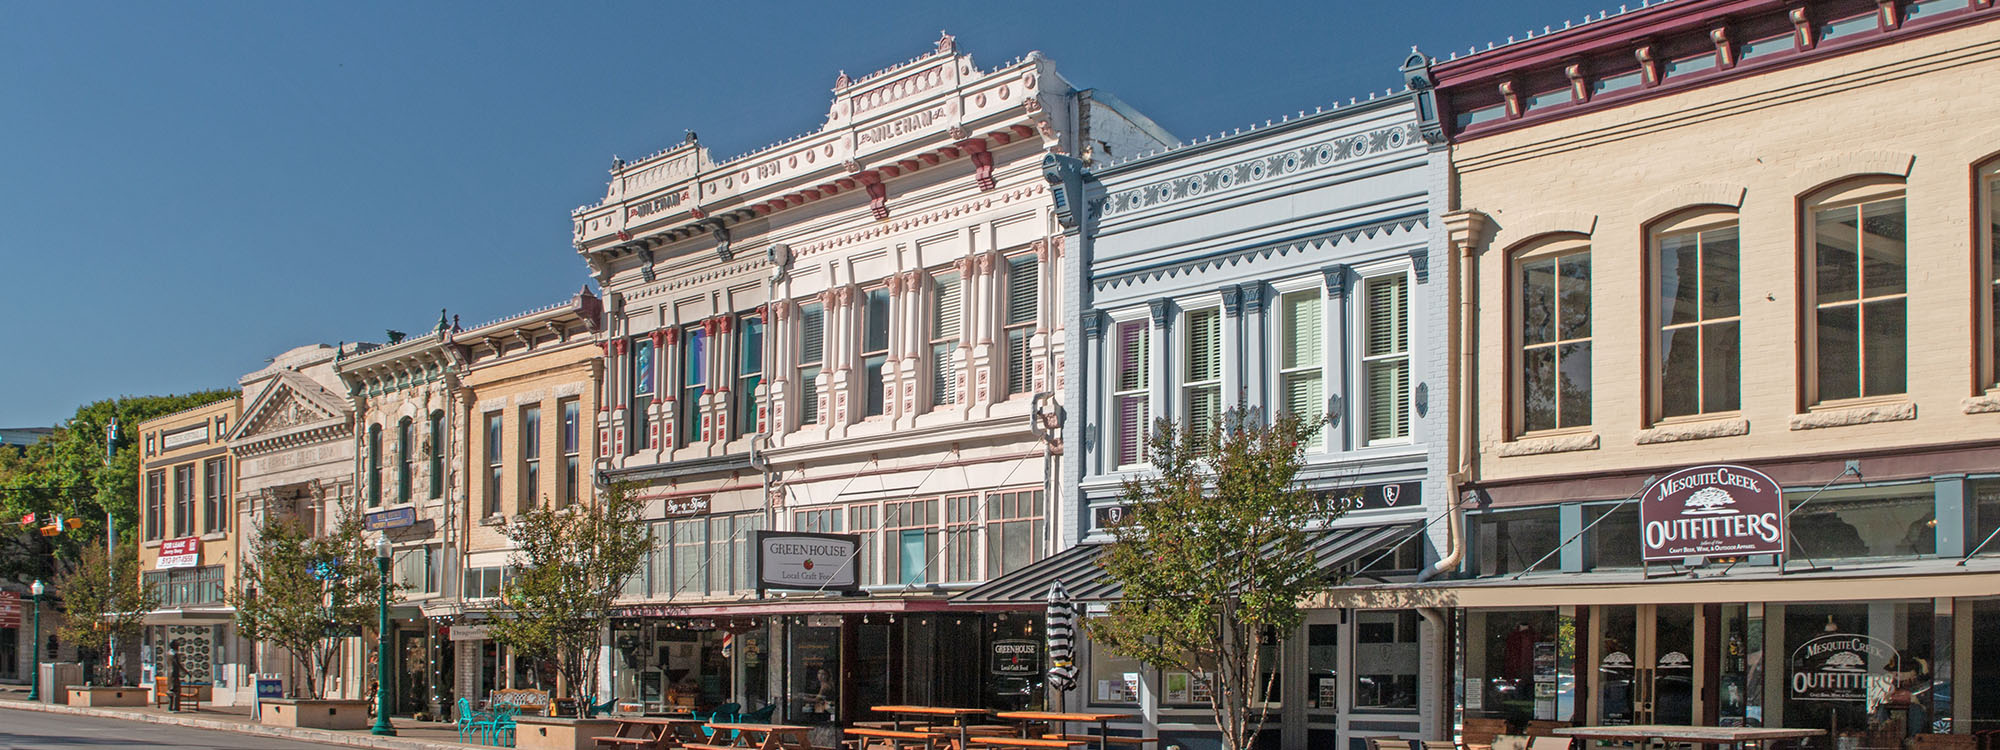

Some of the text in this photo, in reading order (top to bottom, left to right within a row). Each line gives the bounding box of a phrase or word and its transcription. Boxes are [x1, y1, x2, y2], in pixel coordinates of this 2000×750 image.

[871, 110, 933, 144] MILEHAM
[757, 160, 781, 180] 1891
[1646, 512, 1780, 549] OUTFITTERS
[770, 543, 847, 557] GREENHOUSE
[782, 571, 800, 580] Local
[801, 571, 817, 580] Craft
[995, 644, 1036, 654] GREENHOUSE
